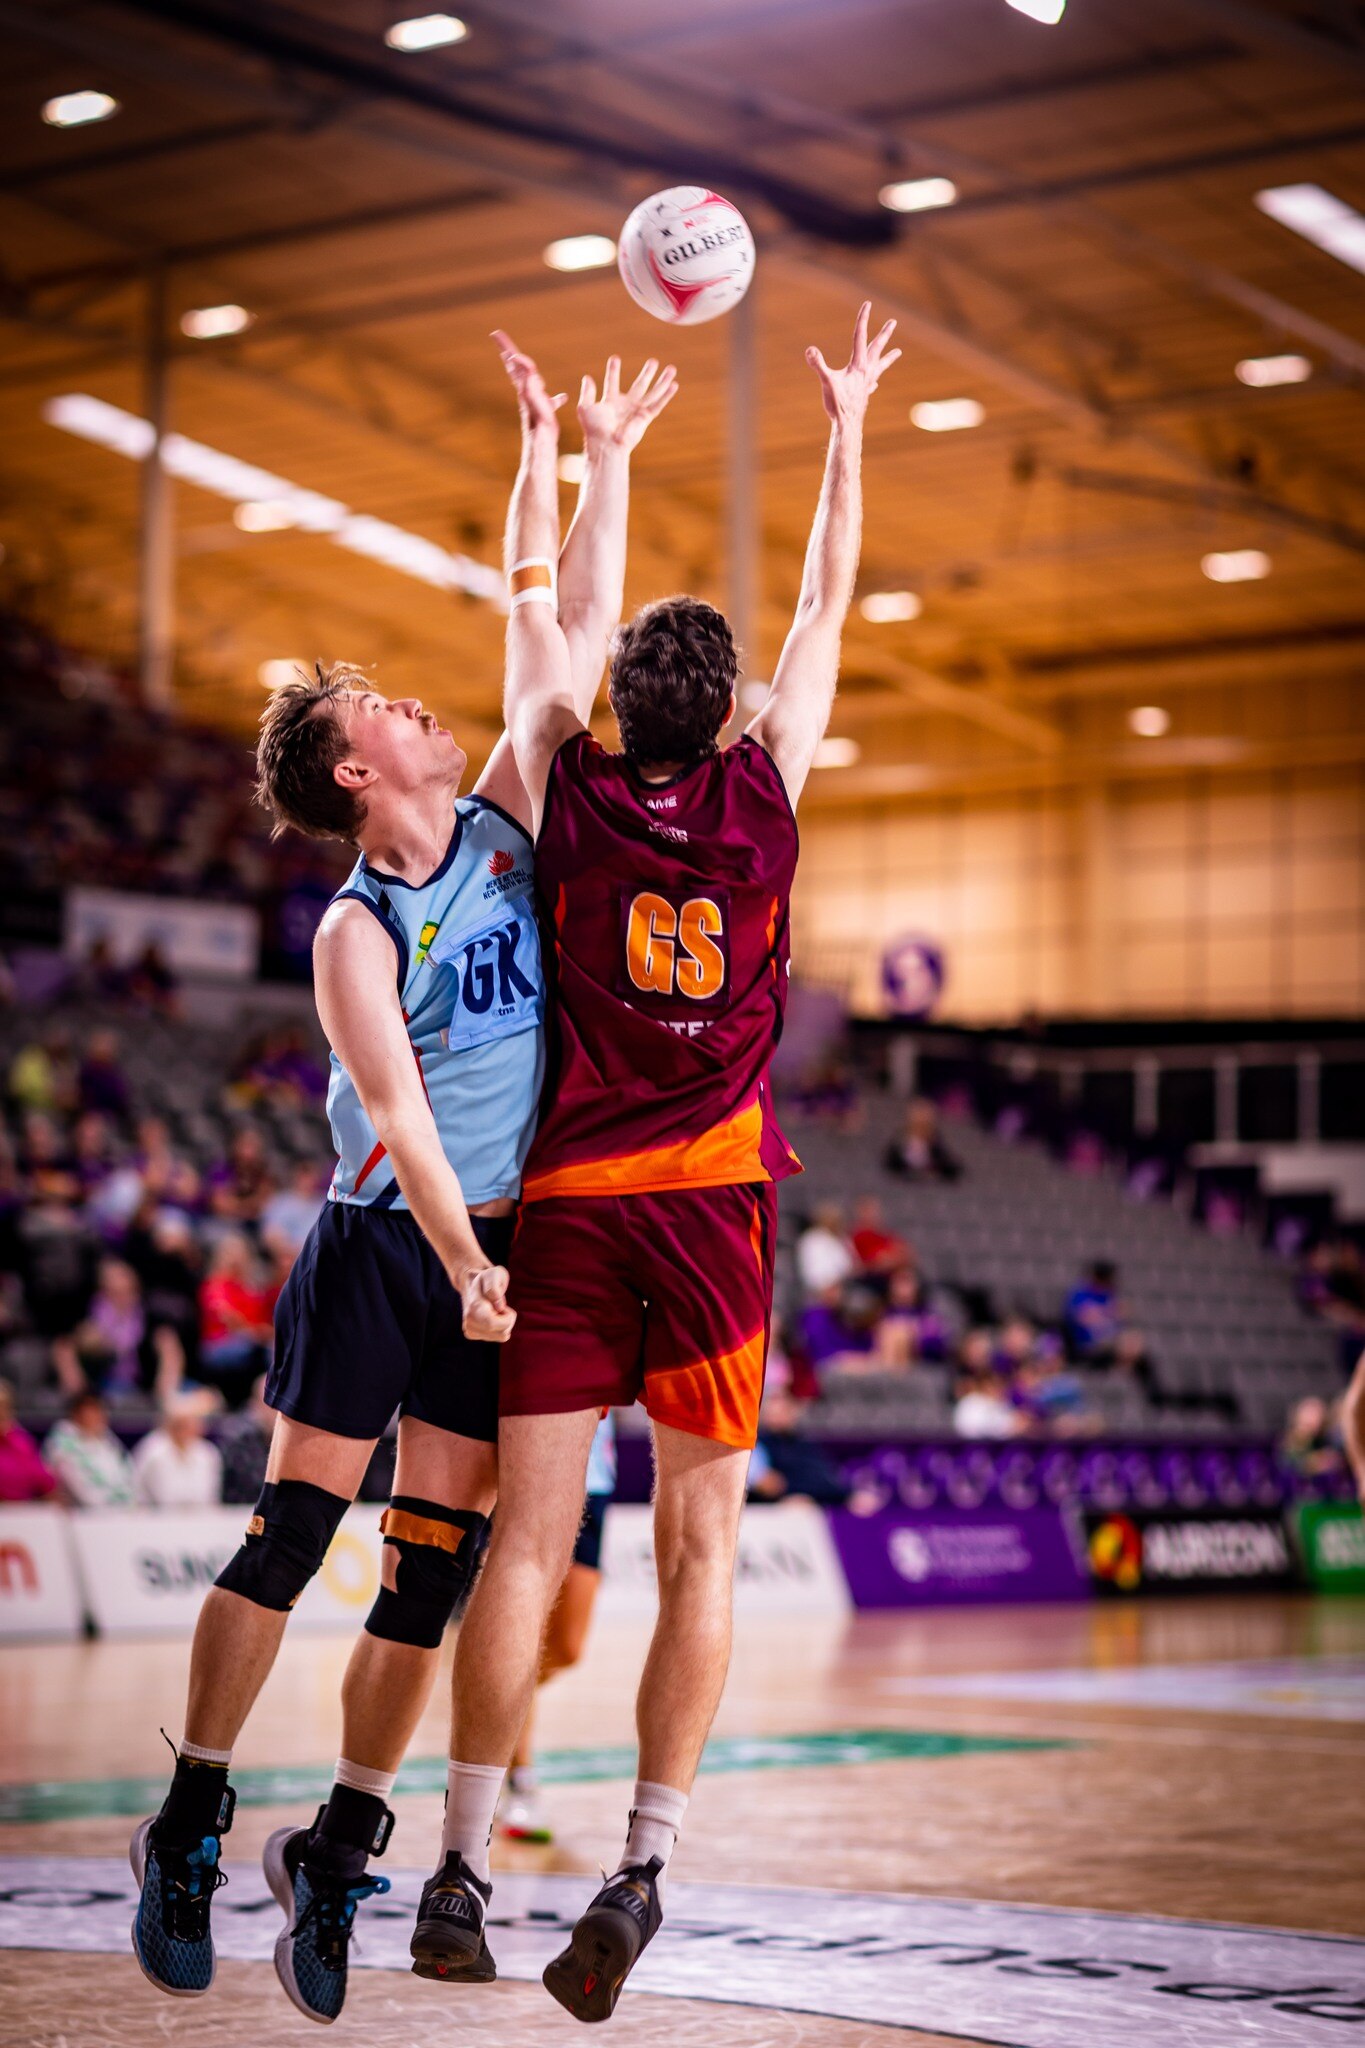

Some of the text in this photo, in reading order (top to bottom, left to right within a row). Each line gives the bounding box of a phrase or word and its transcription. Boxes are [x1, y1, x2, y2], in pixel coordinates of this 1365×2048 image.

[482, 888, 498, 900] NEW
[497, 879, 517, 893] SOUTH
[502, 868, 526, 882] NETBALL
[462, 921, 539, 1015] GK
[626, 891, 725, 1000] GS
